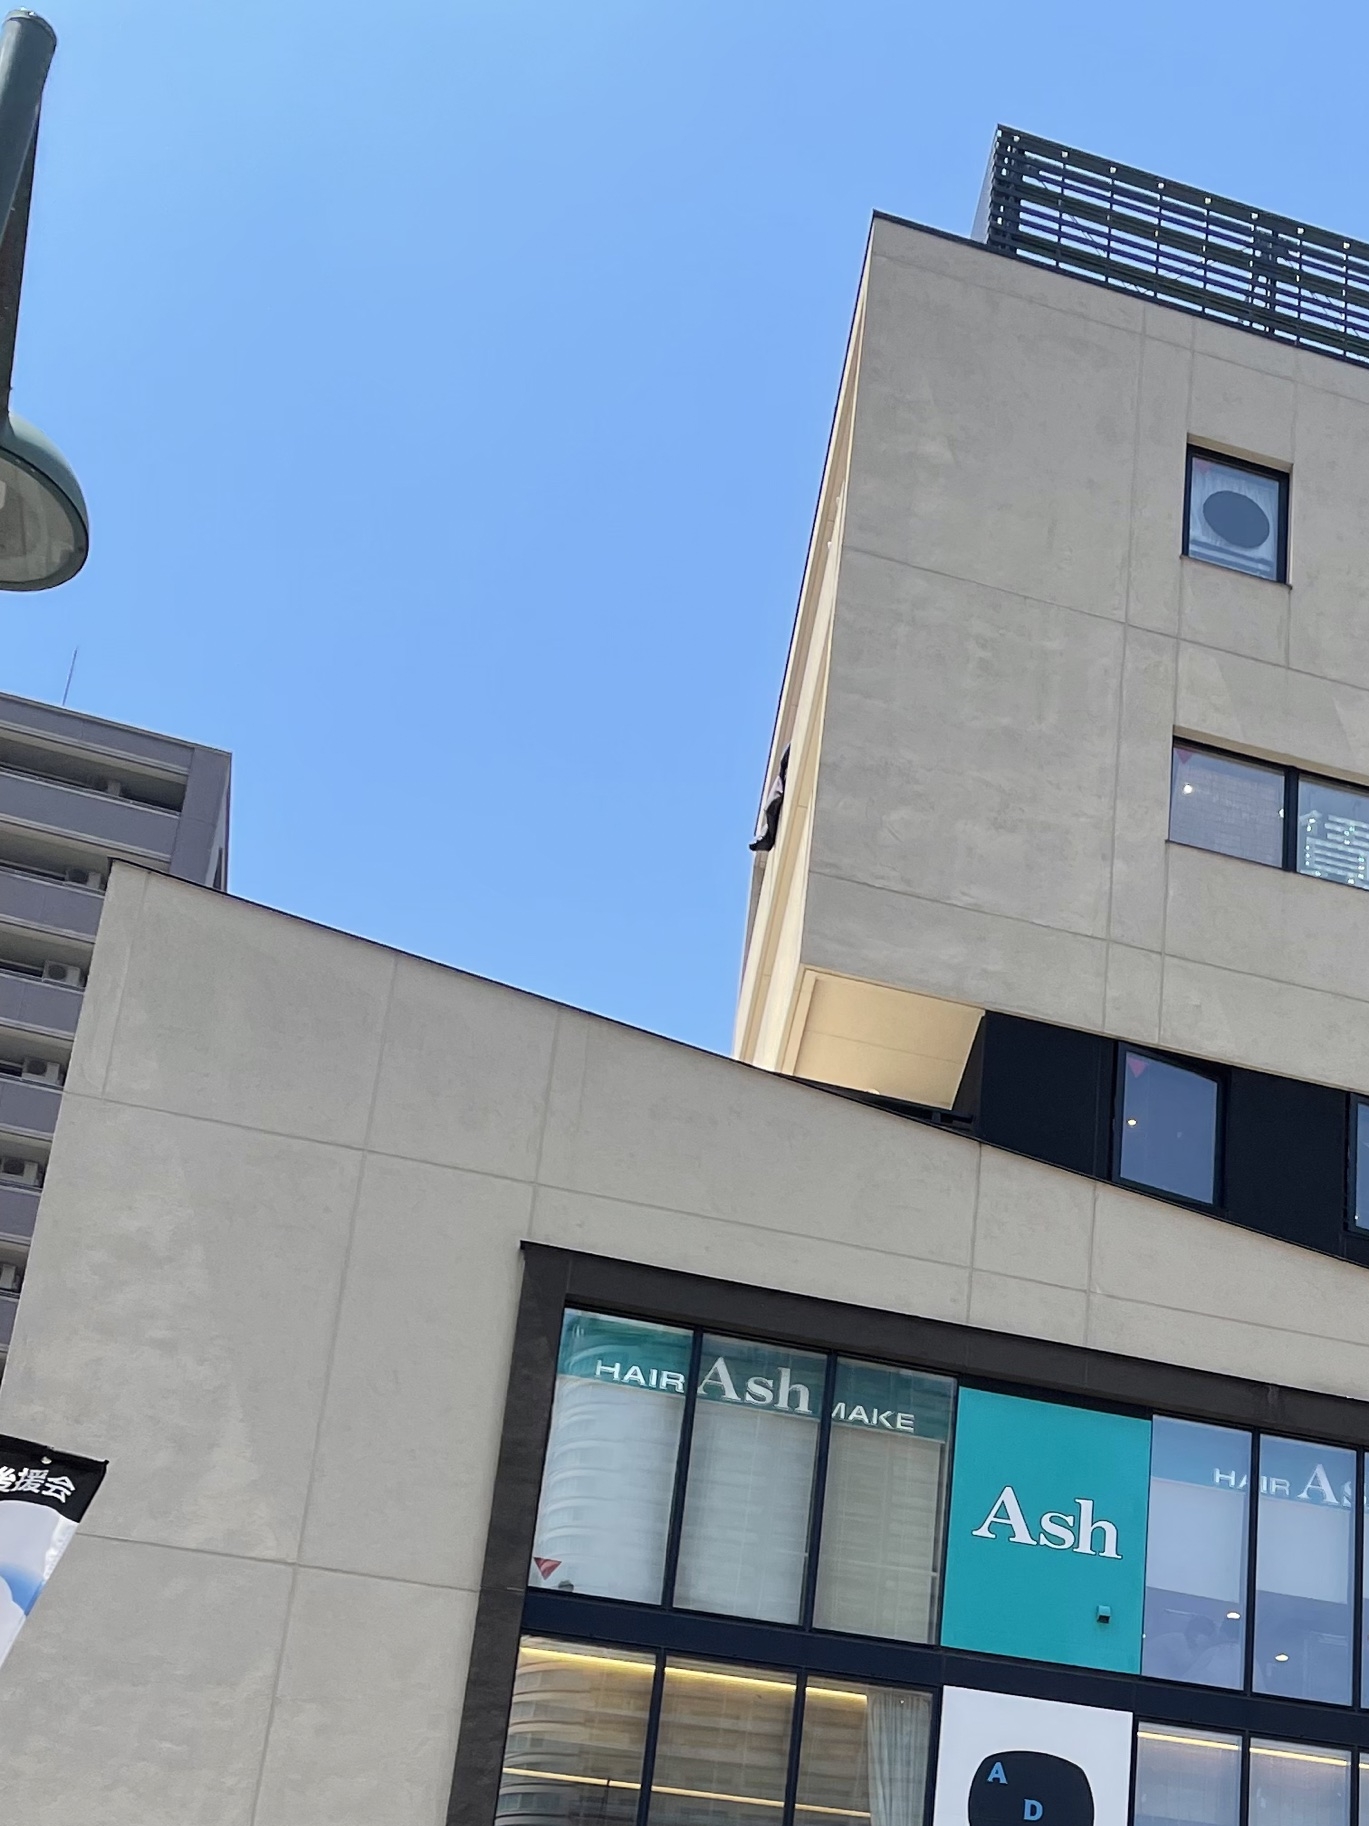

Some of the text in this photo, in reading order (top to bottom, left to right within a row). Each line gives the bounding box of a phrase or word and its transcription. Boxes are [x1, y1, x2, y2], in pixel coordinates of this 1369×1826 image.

[594, 1358, 686, 1396] HAIR
[696, 1355, 813, 1415] Ash
[971, 1485, 1124, 1560] Ash
[986, 1761, 1009, 1785] A
[1023, 1799, 1044, 1821] D
